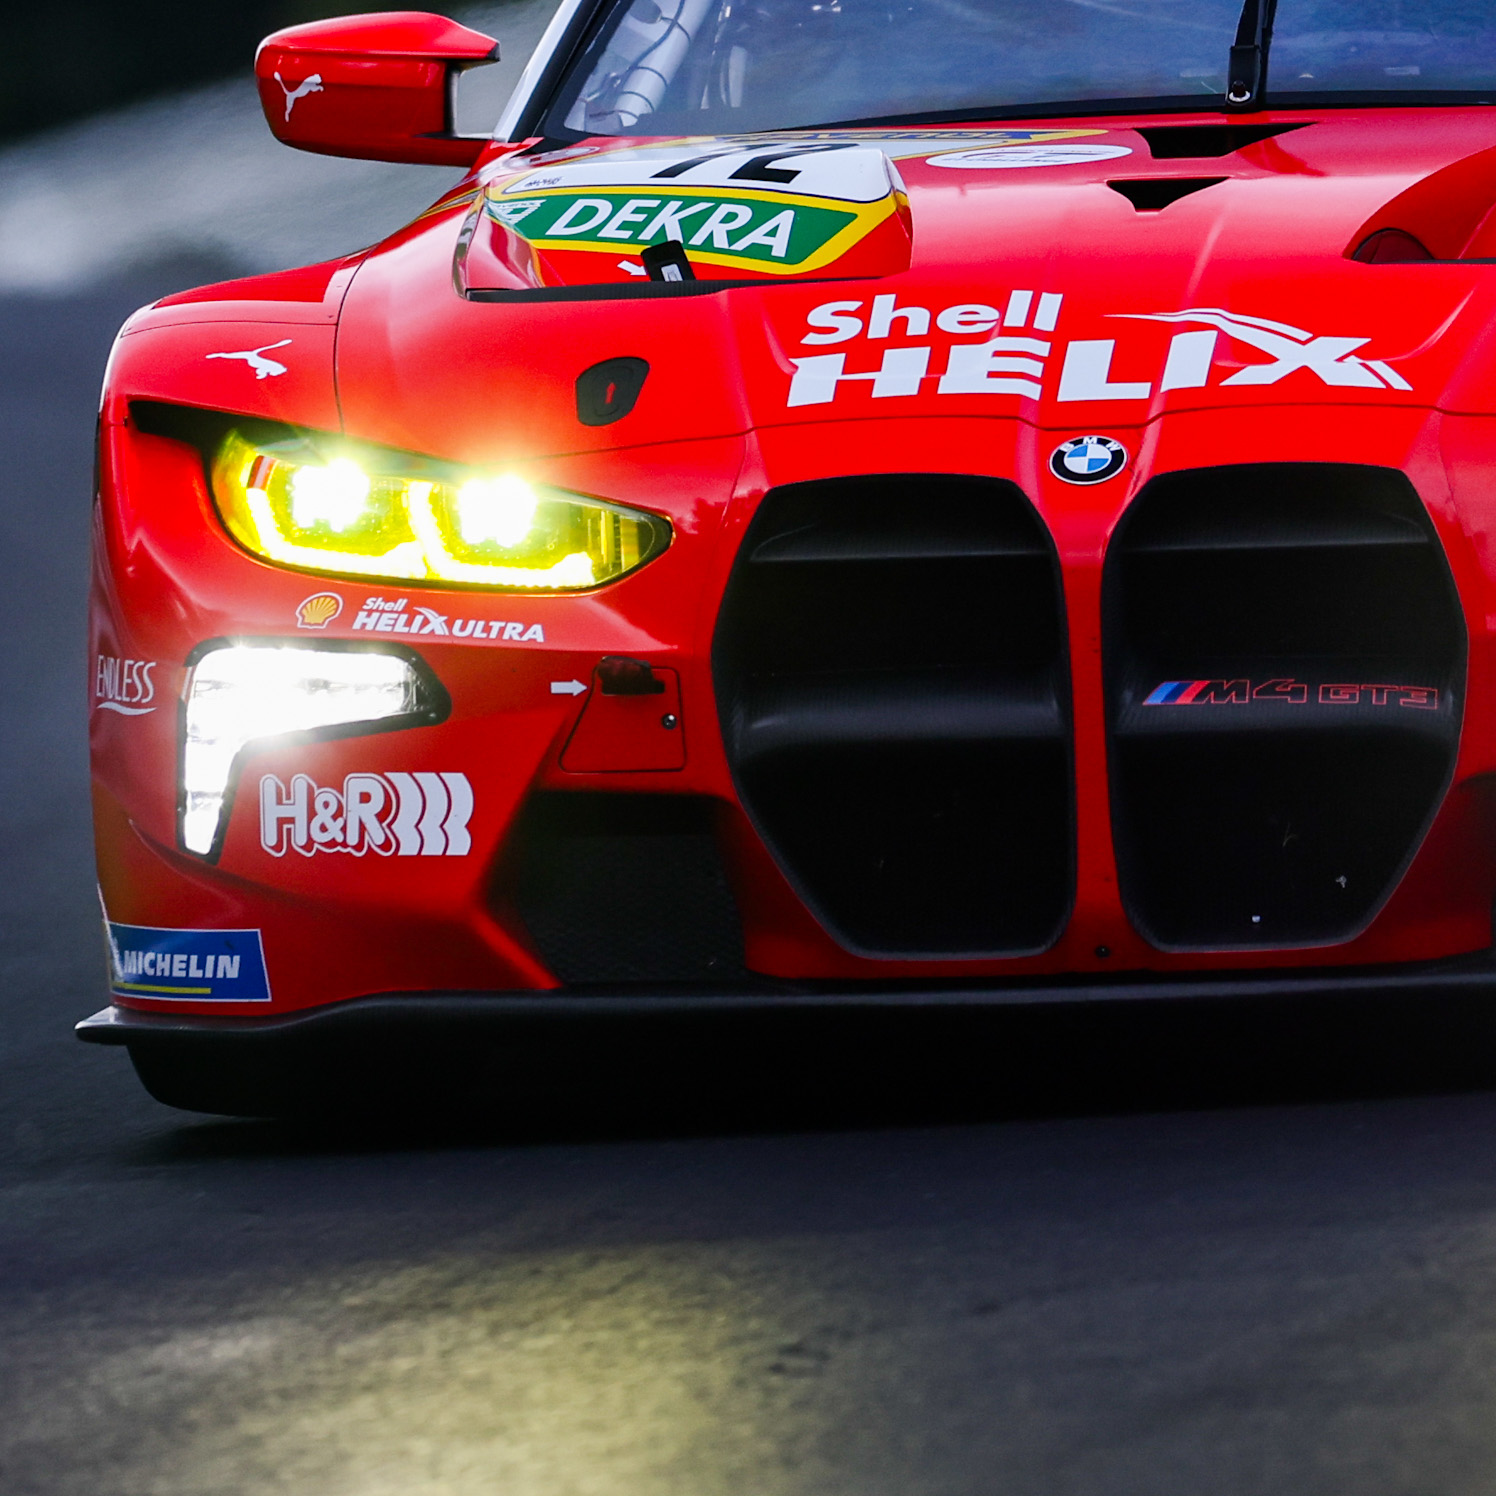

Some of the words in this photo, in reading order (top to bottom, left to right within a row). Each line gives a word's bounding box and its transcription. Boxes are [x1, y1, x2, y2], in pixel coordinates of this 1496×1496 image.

[545, 198, 795, 258] DEKRA
[800, 289, 1064, 346] Shell
[786, 308, 1414, 408] HELIX
[352, 606, 449, 636] HELIX
[452, 619, 545, 643] ULTRA
[362, 597, 409, 612] Shell
[1195, 678, 1308, 705] M4
[1318, 683, 1438, 710] GT3
[259, 772, 397, 857] H&R
[123, 950, 241, 979] MICHELIN
